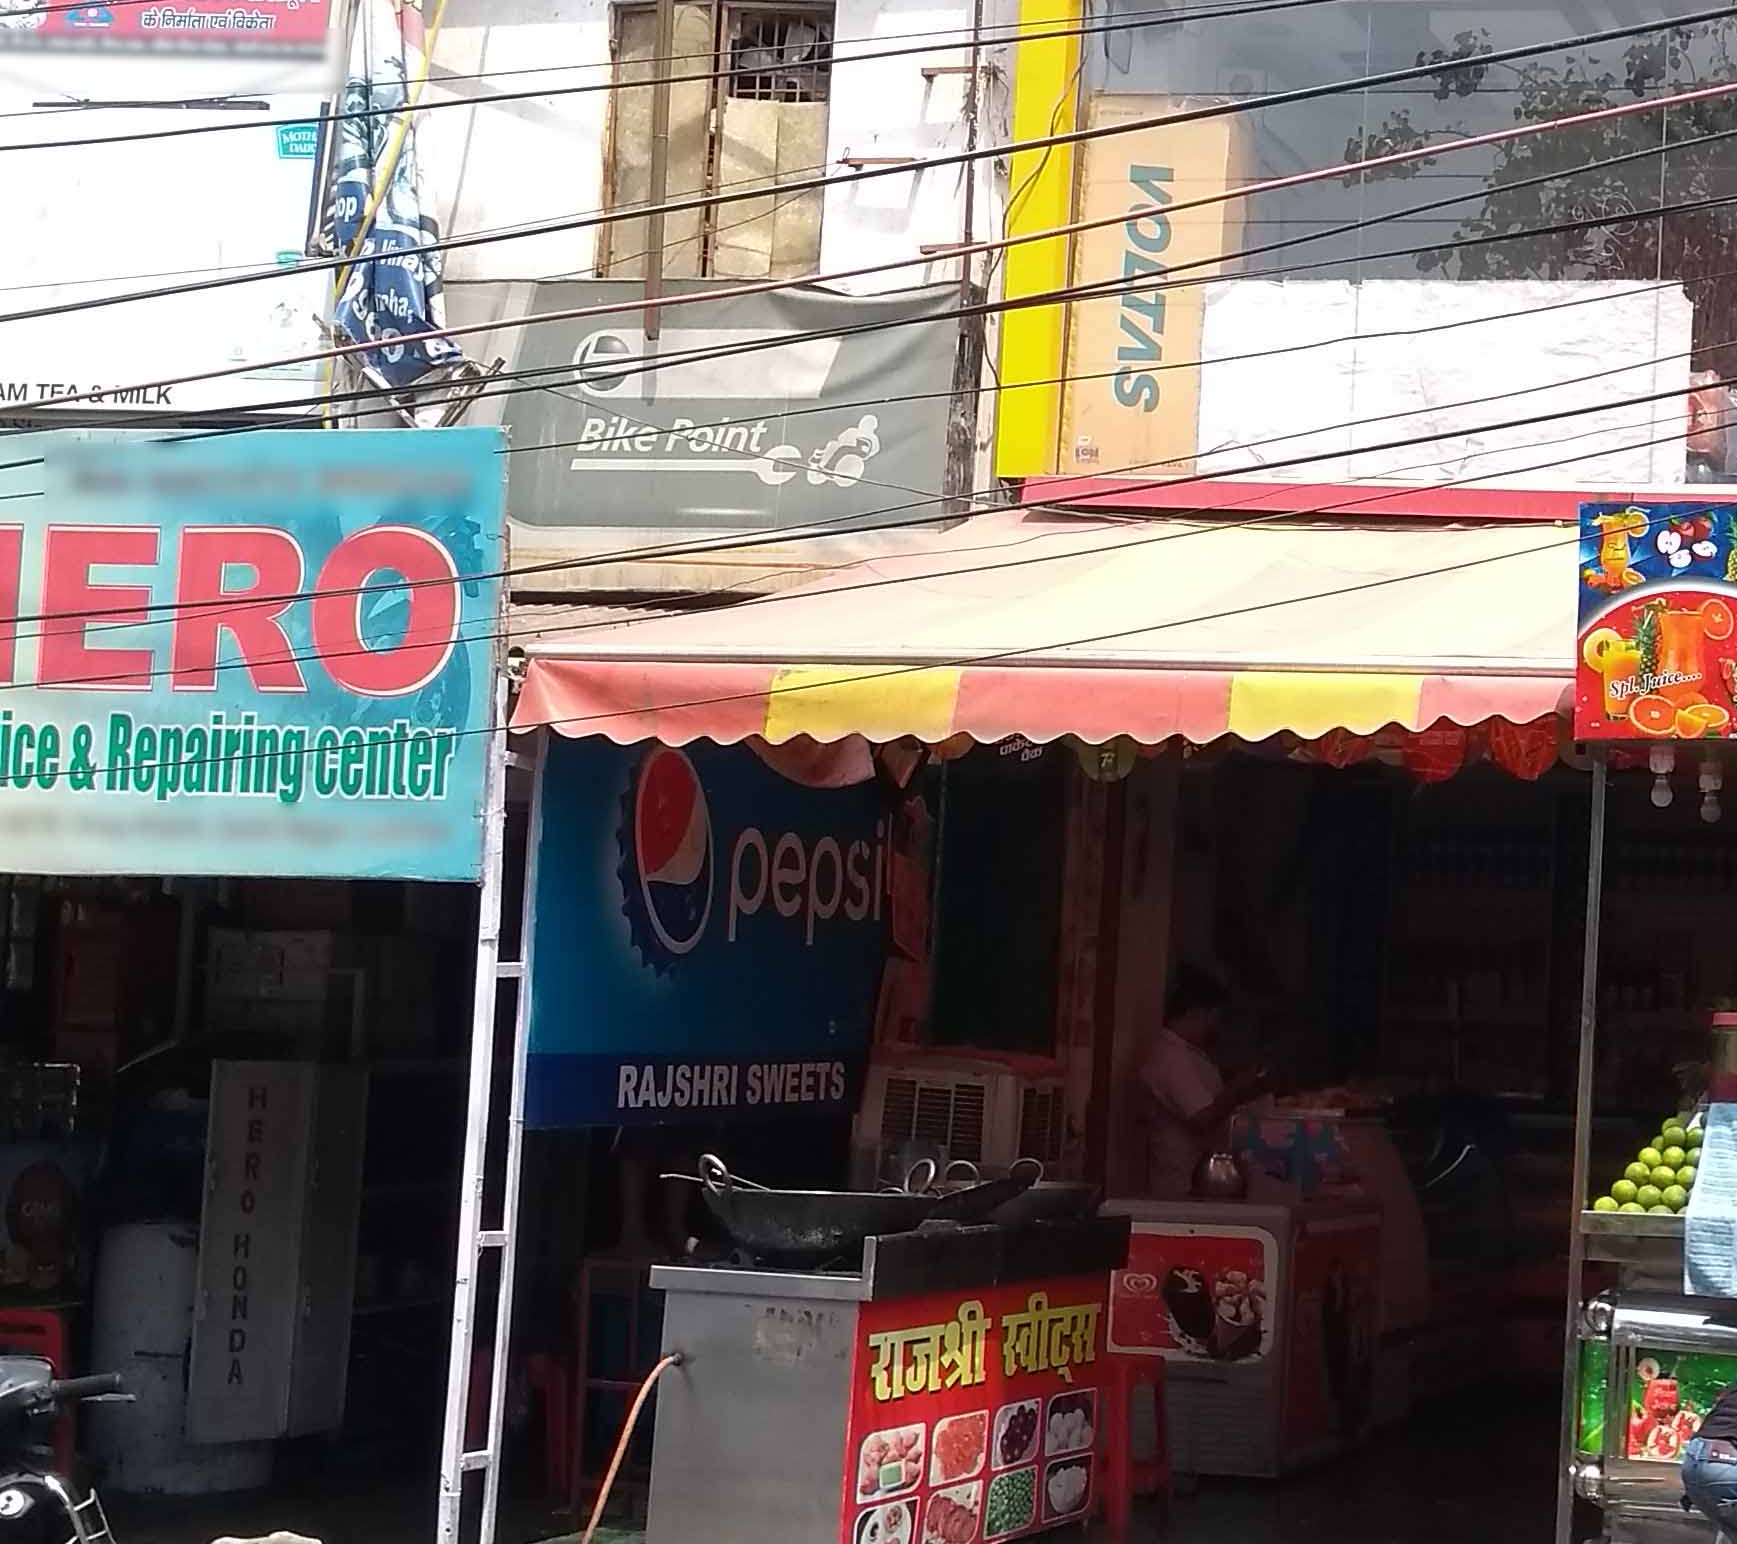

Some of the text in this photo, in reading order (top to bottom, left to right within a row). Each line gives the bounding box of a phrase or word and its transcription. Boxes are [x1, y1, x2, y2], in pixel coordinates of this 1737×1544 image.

[1113, 163, 1175, 414] VOLTAS
[112, 384, 173, 405] MILK
[575, 416, 770, 454] Bike Point
[69, 722, 97, 793] &
[105, 711, 305, 804] Repairing
[313, 719, 457, 801] center
[728, 818, 884, 945] pepsi
[616, 1062, 845, 1109] RAJSHRI SWEETS
[226, 1087, 268, 1386] HERO HONDA
[868, 1299, 992, 1402] राजश्री
